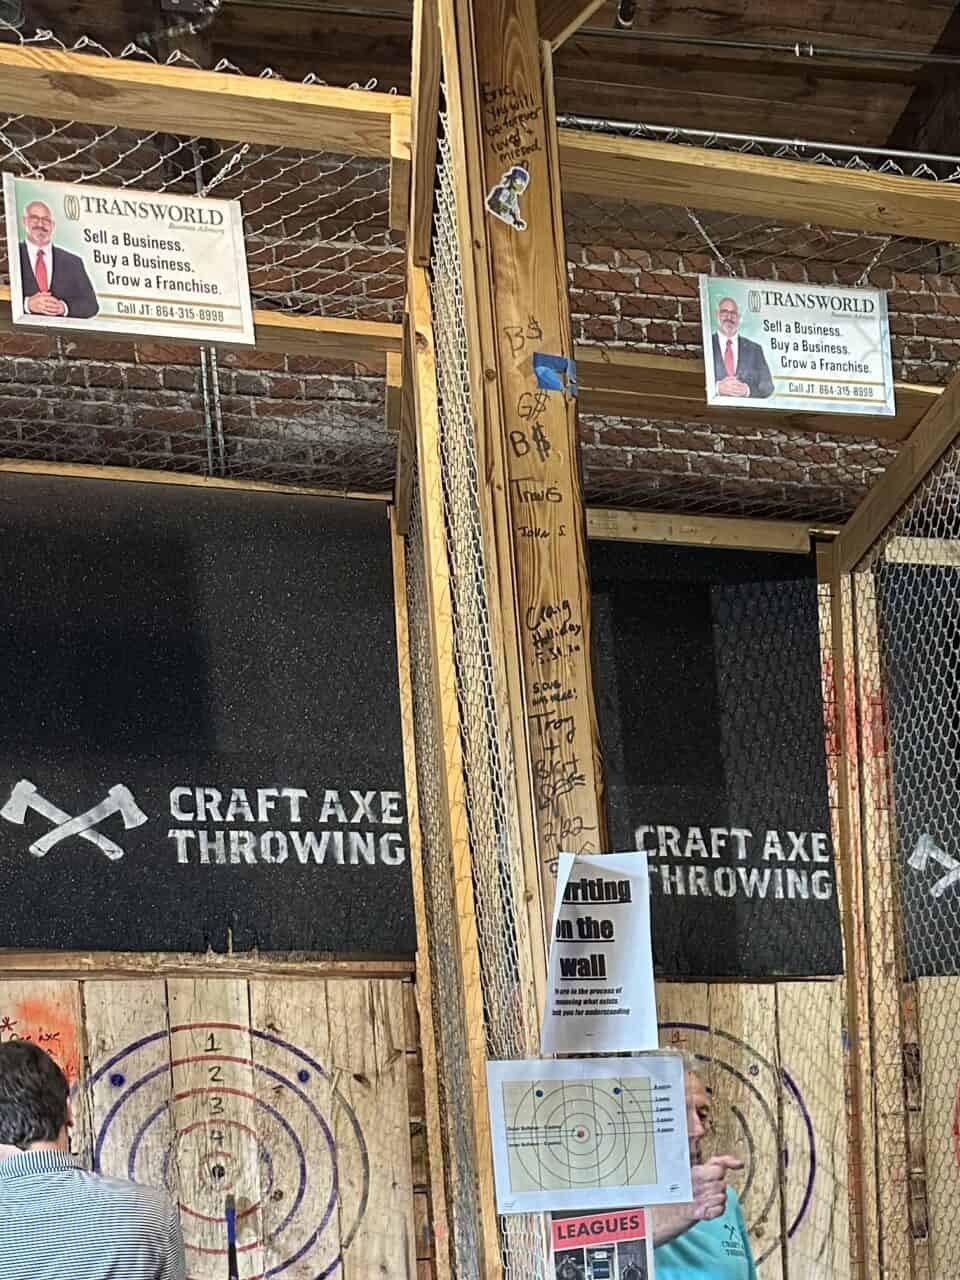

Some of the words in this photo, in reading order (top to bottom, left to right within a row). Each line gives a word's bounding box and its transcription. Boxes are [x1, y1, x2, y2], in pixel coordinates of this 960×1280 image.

[80, 195, 224, 226] TRANSWORLD
[84, 228, 108, 244] Sell
[111, 236, 119, 246] a
[123, 232, 185, 253] Business.
[94, 249, 118, 269] Buy
[121, 256, 129, 267] a
[133, 253, 195, 274] Business.
[107, 271, 140, 287] Grow
[145, 279, 152, 288] a
[156, 275, 223, 296] Franchise.
[117, 301, 136, 315] Call
[761, 290, 875, 314] TRANSWORLD
[763, 320, 783, 333] Sell
[785, 323, 792, 334] a
[770, 337, 790, 352] Buy
[793, 341, 799, 351] a
[781, 355, 808, 369] Grow
[811, 360, 817, 370] a
[820, 358, 873, 375] Franchise.
[788, 381, 804, 393] Call
[169, 786, 309, 823] CRAFT
[318, 789, 404, 825] AXE
[167, 829, 407, 866] THROWING
[634, 824, 753, 859] CRAFT
[761, 829, 831, 863] AXE
[576, 916, 614, 940] the
[559, 953, 607, 978] wall
[204, 1032, 222, 1052] 1
[207, 1065, 225, 1083] 2
[208, 1096, 225, 1115] 3
[556, 1214, 641, 1241] LEAGUES
